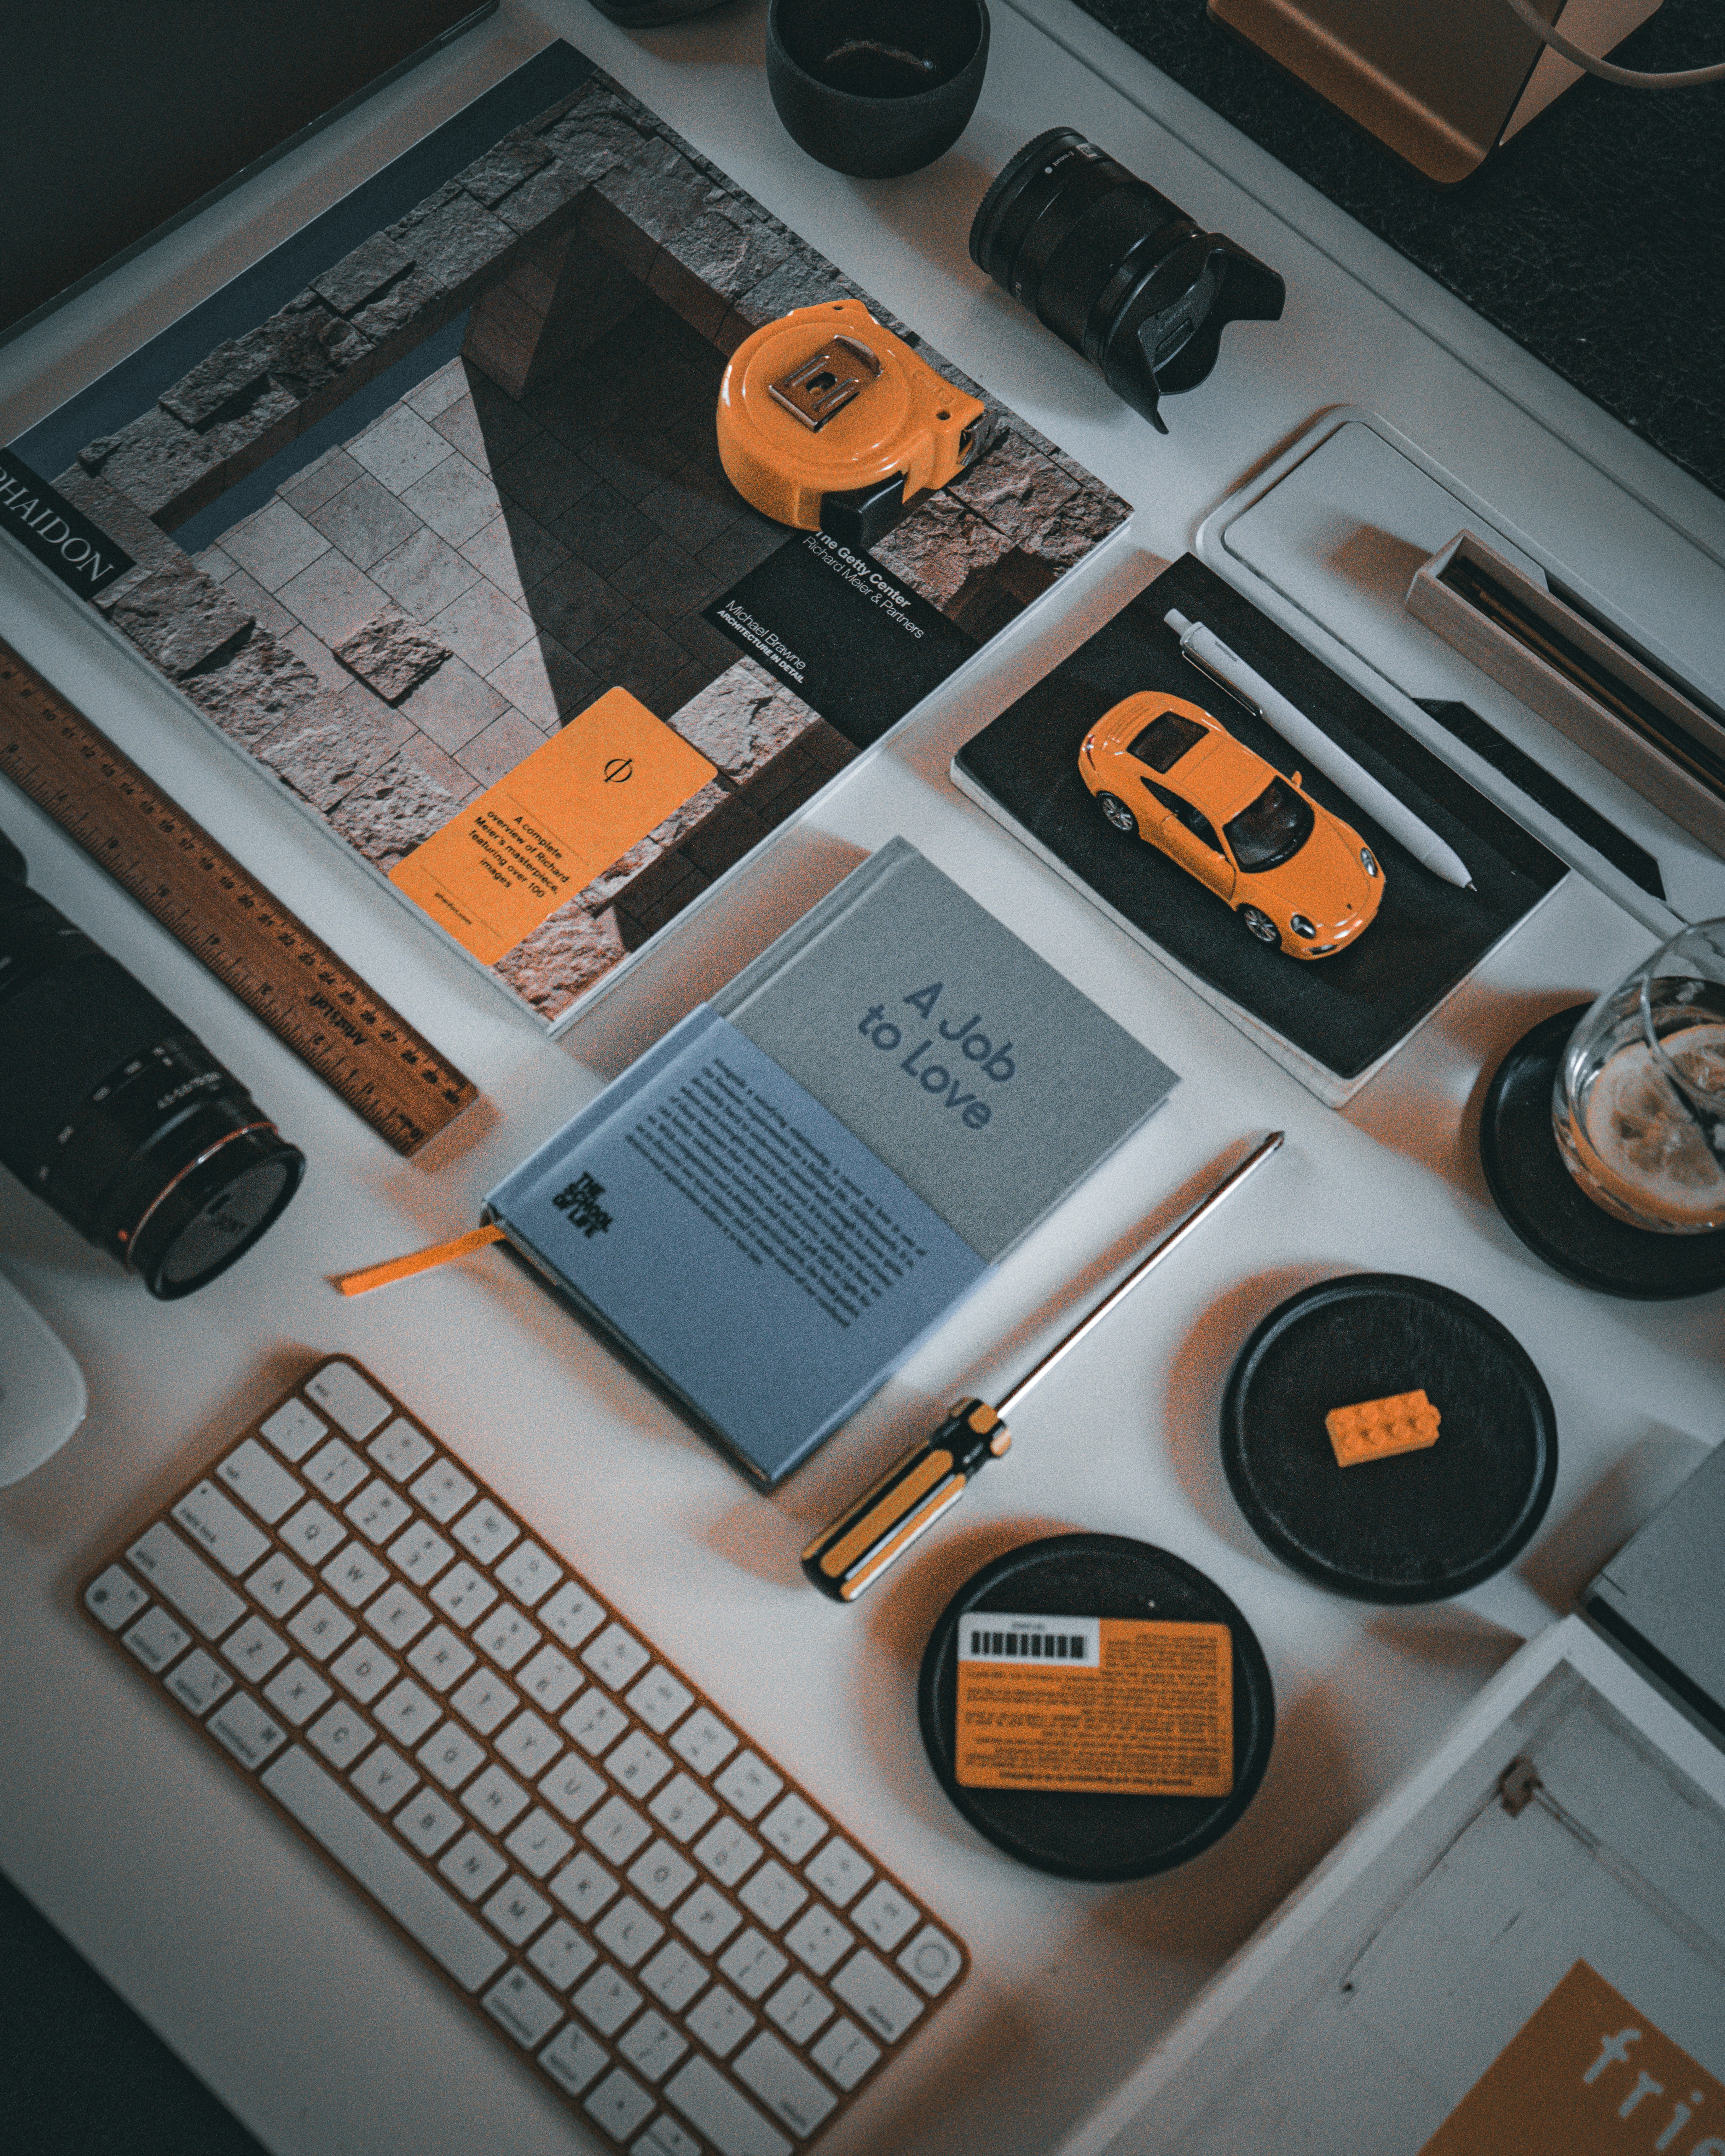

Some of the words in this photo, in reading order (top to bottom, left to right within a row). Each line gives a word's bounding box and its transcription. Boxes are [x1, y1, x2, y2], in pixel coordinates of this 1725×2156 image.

[803, 536, 846, 572] Richard
[841, 568, 873, 595] Meier
[870, 593, 882, 604] &
[879, 599, 924, 638] Partners
[838, 547, 871, 576] Getty
[869, 573, 911, 607] Center
[717, 610, 773, 656] ARCHITECTURE
[770, 654, 781, 663] IN
[778, 660, 804, 683] DETAIL
[725, 600, 770, 637] Michael
[764, 633, 806, 670] Brawne
[469, 830, 508, 867] featuring
[507, 865, 527, 882] over
[529, 882, 545, 898] 100
[480, 859, 511, 888] images
[487, 811, 525, 844] overview
[525, 845, 538, 853] of
[535, 852, 569, 883] Richard
[505, 845, 558, 895] masterpiece,
[522, 824, 562, 859] complete
[903, 981, 944, 1020] A
[938, 1014, 1017, 1082] Job
[858, 1003, 902, 1050] to
[901, 1039, 991, 1130] Love
[562, 1183, 612, 1232] SCHOOL
